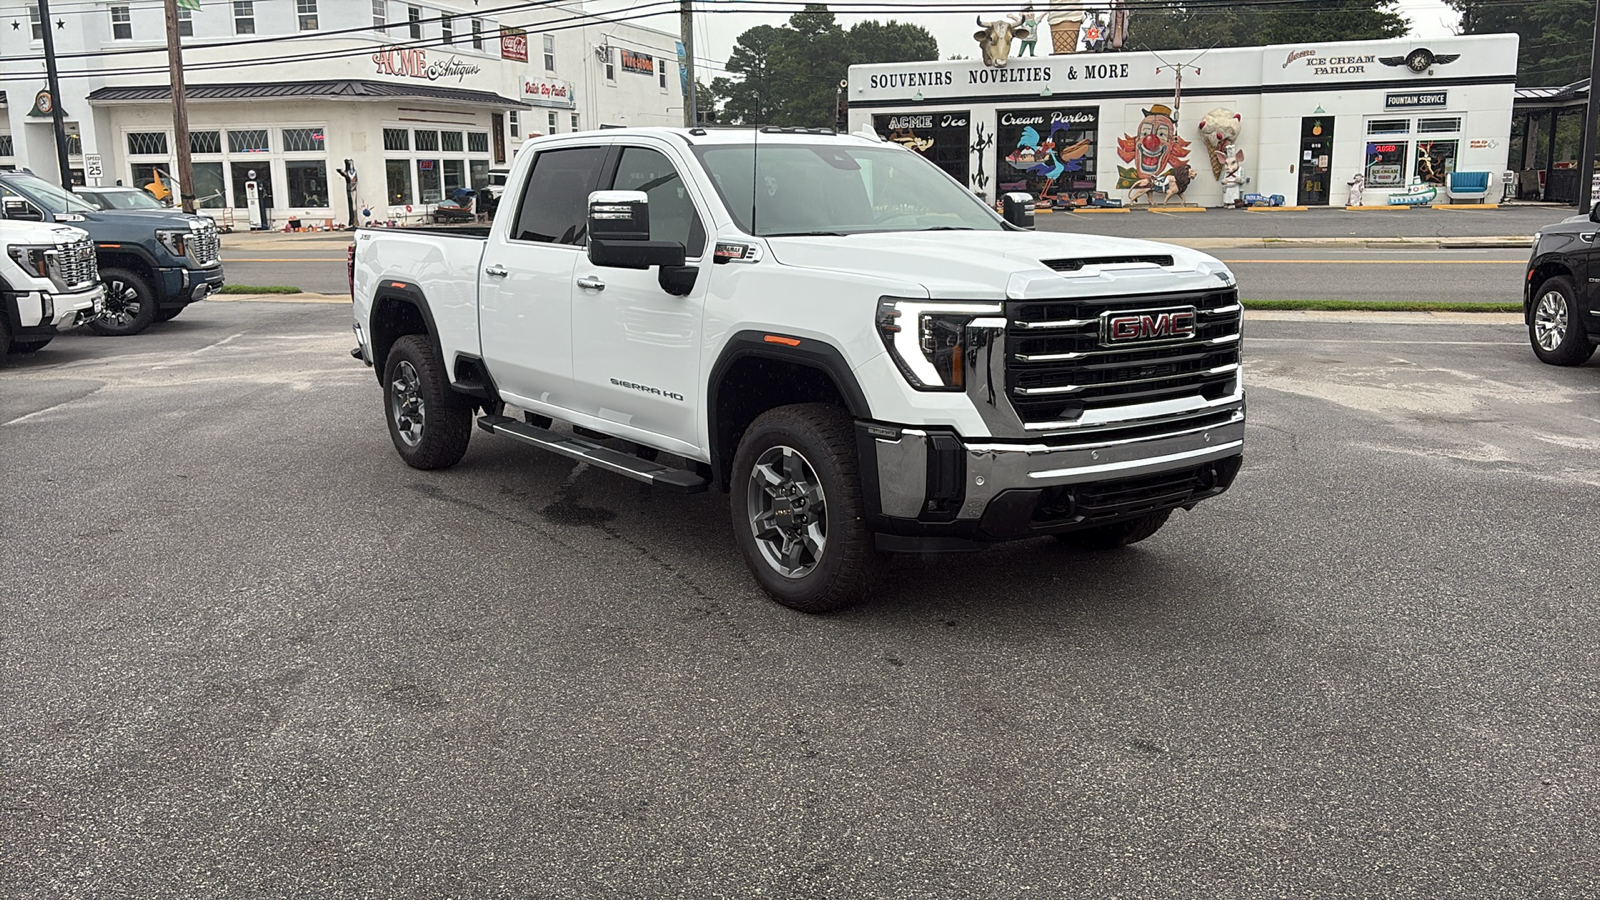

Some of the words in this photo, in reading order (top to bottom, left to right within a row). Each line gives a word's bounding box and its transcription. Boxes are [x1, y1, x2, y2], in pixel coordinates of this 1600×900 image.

[372, 45, 427, 79] ACME
[438, 55, 481, 83] Antiques
[1306, 57, 1327, 66] ICE
[1329, 55, 1375, 65] CREAM
[870, 71, 952, 89] SOUVENIRS
[968, 67, 1051, 84] NOVELTIES
[1067, 66, 1078, 80] &
[1084, 63, 1129, 80] MORE
[1314, 65, 1365, 75] PARLOR
[525, 81, 540, 95] Dutch
[541, 83, 551, 99] Boy
[551, 84, 567, 98] Paints
[1388, 96, 1418, 105] FOUNTAIN
[1419, 94, 1445, 104] SERVICE
[888, 115, 933, 129] ACME
[940, 114, 968, 127] Ice
[1001, 113, 1044, 126] Cream
[1050, 111, 1096, 124] Parlor
[89, 166, 101, 175] 25
[1110, 313, 1194, 340] GMC
[610, 377, 661, 396] SIERRA
[663, 390, 684, 401] HD
